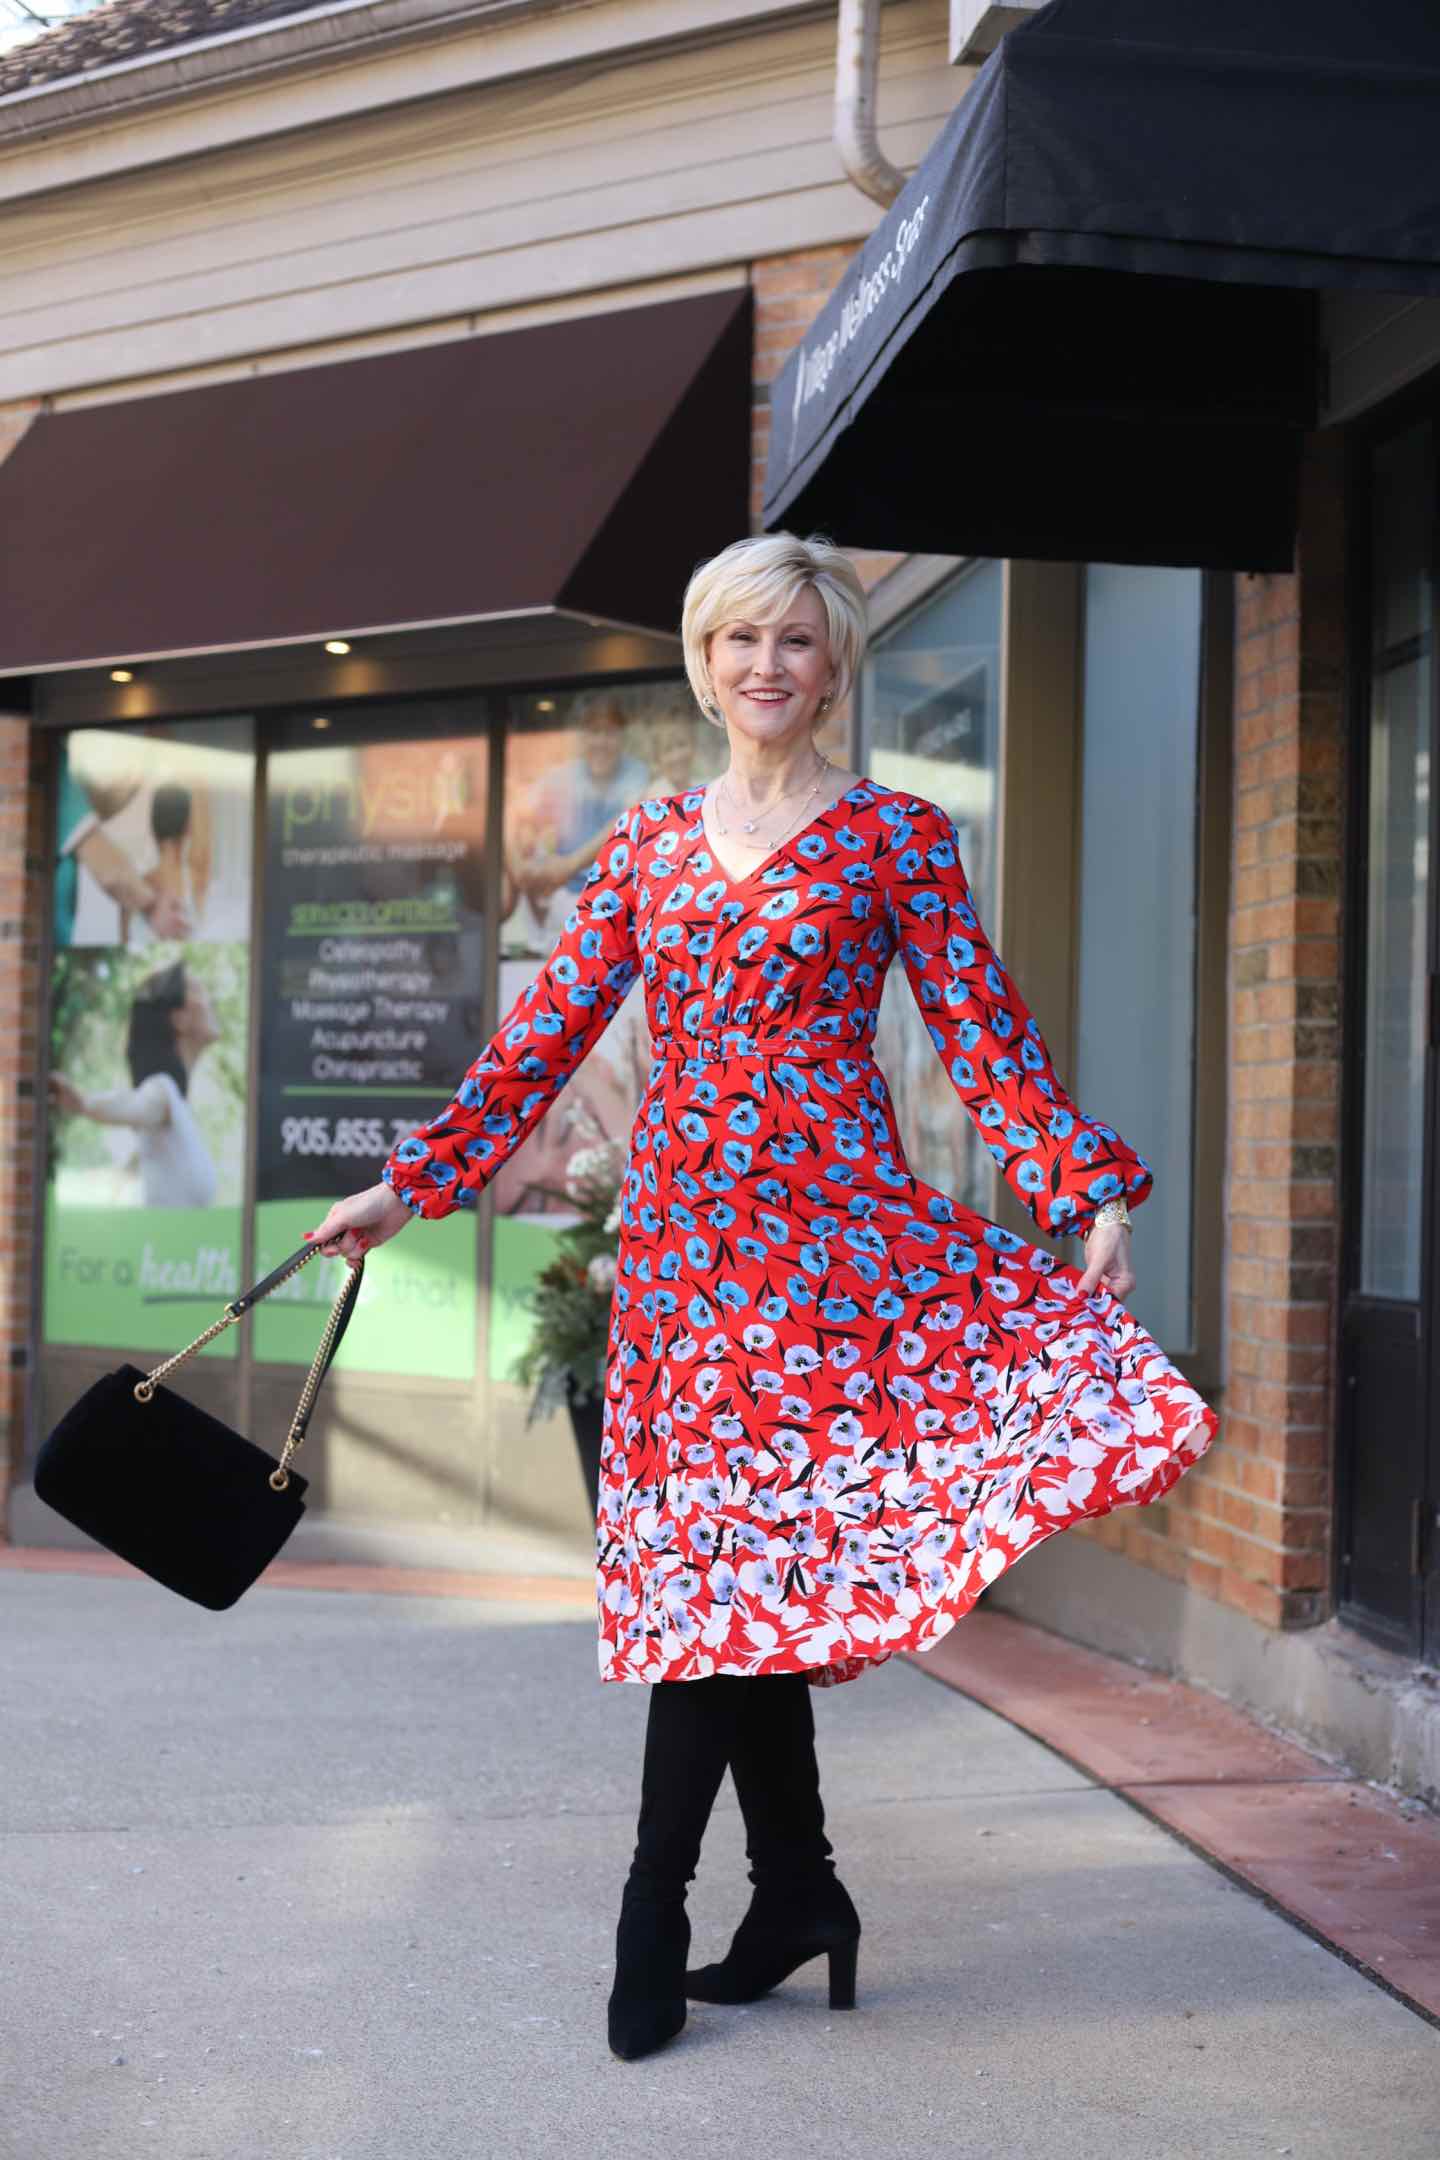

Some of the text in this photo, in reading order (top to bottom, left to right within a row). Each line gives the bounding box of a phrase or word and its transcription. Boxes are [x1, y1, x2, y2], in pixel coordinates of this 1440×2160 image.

[291, 997, 449, 1025] Massage Therapy
[310, 1027, 427, 1053] Acupuncture
[312, 1056, 423, 1083] Chiropractic
[60, 1247, 106, 1285] For
[112, 1257, 133, 1287] a
